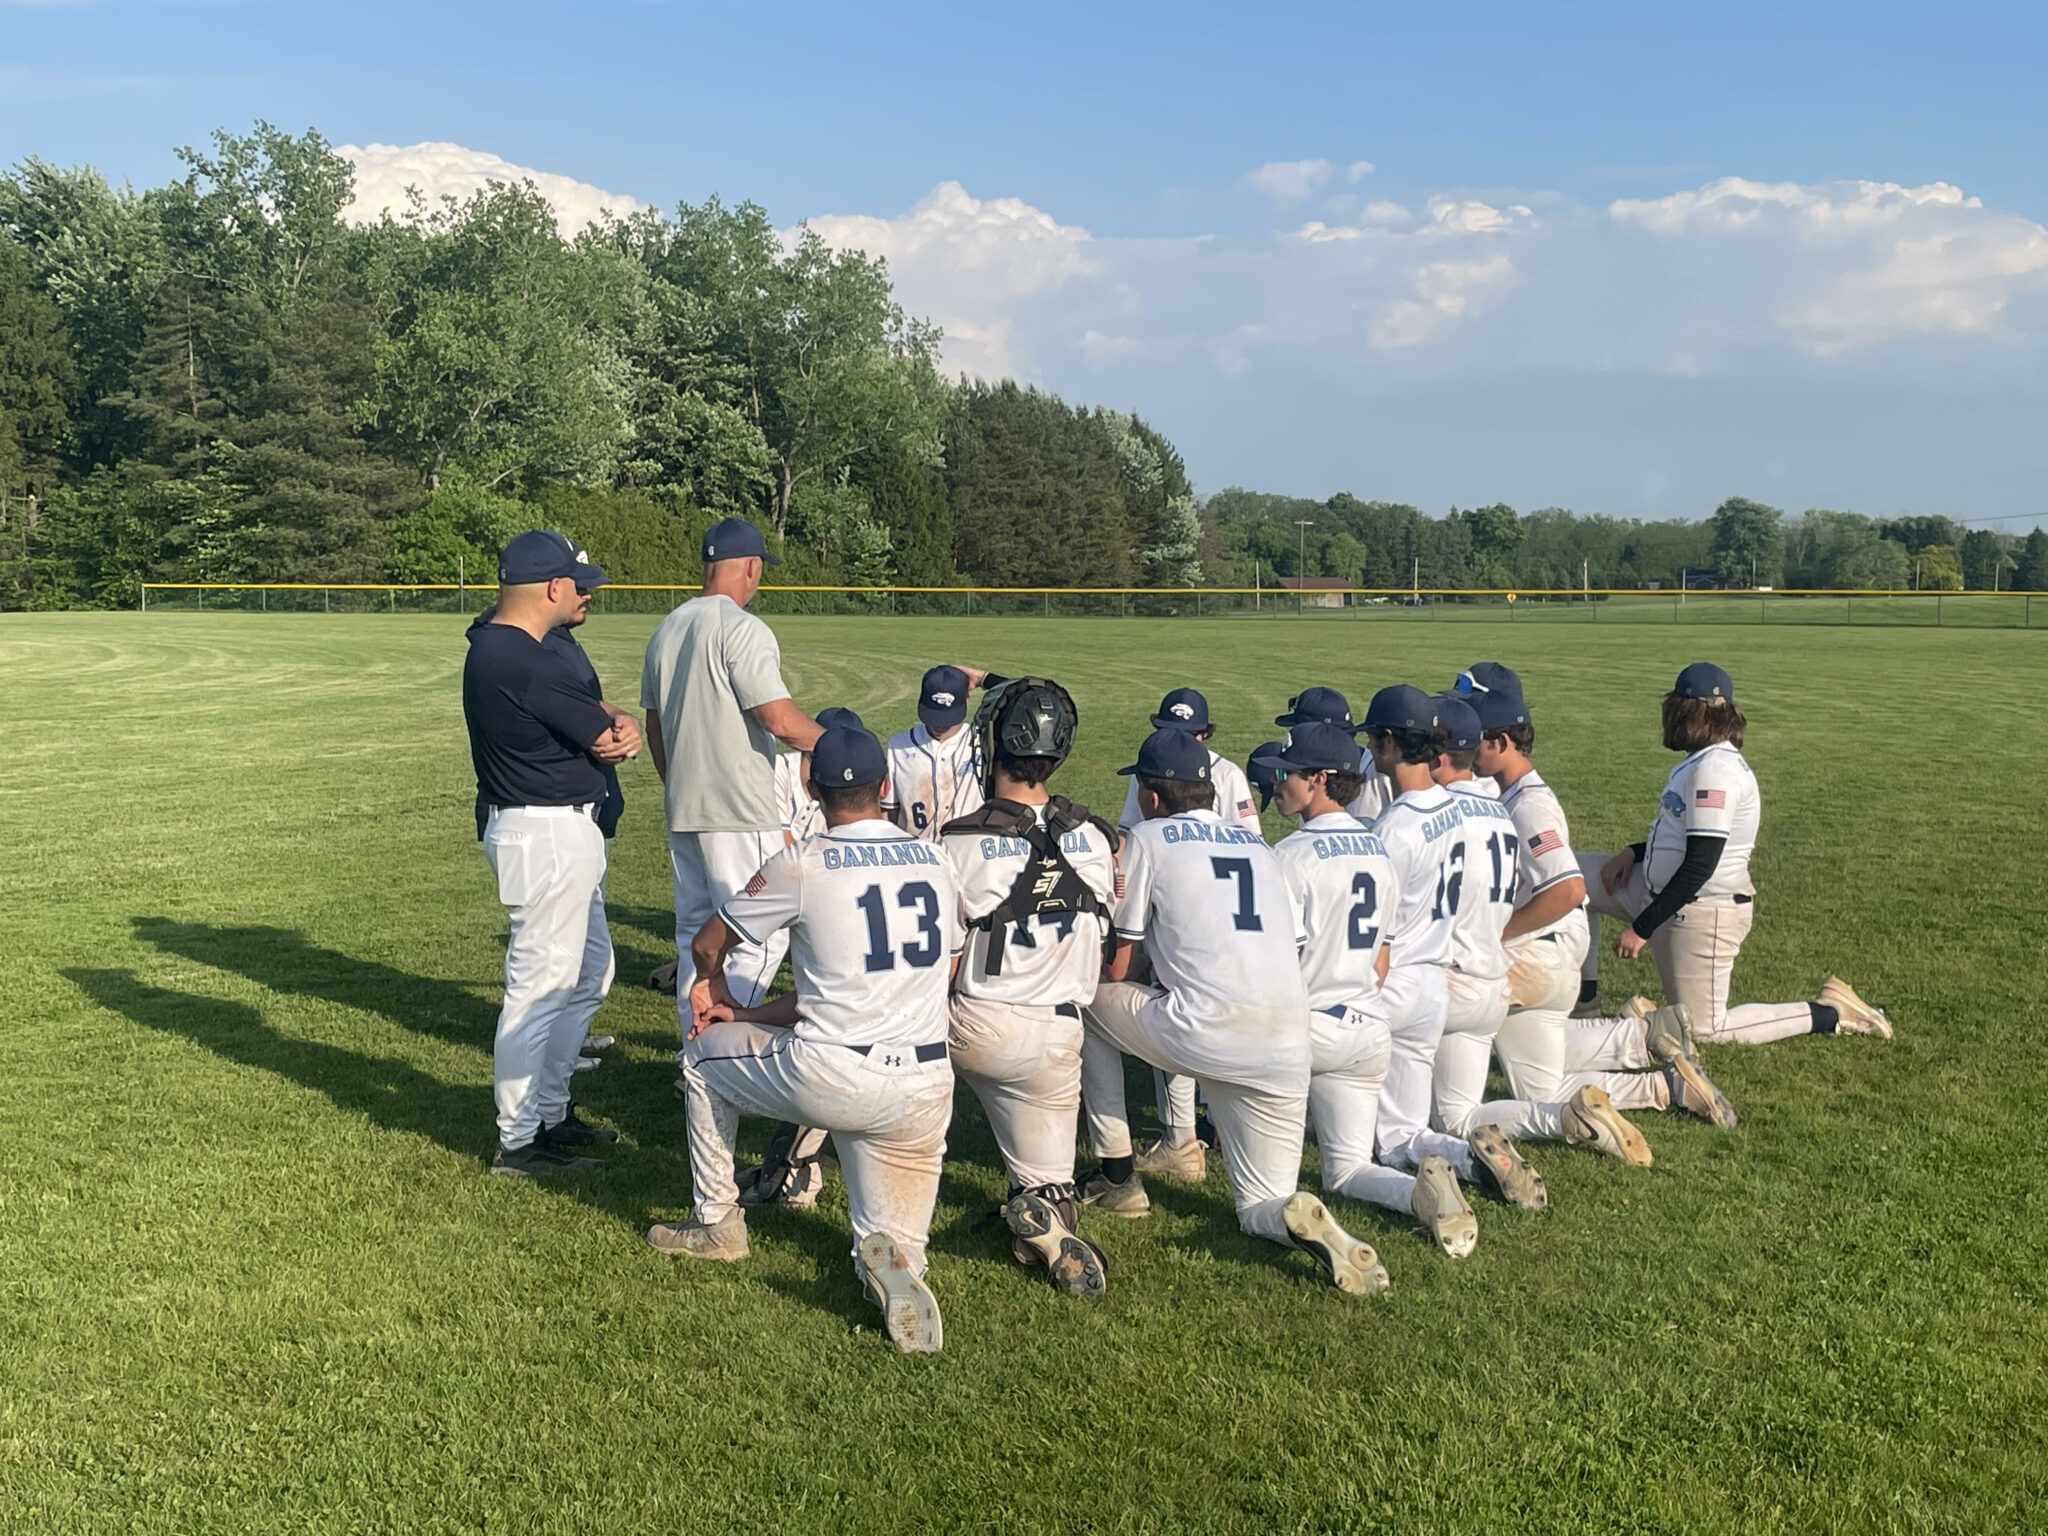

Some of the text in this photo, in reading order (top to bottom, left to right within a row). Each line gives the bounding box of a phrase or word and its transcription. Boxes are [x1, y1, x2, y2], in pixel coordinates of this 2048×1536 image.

[843, 767, 853, 781] G
[912, 801, 927, 830] 6
[980, 831, 1092, 860] GANDA
[1209, 855, 1264, 932] 7
[1486, 830, 1518, 904] 17
[855, 880, 942, 975] 13
[1347, 871, 1379, 950] 2
